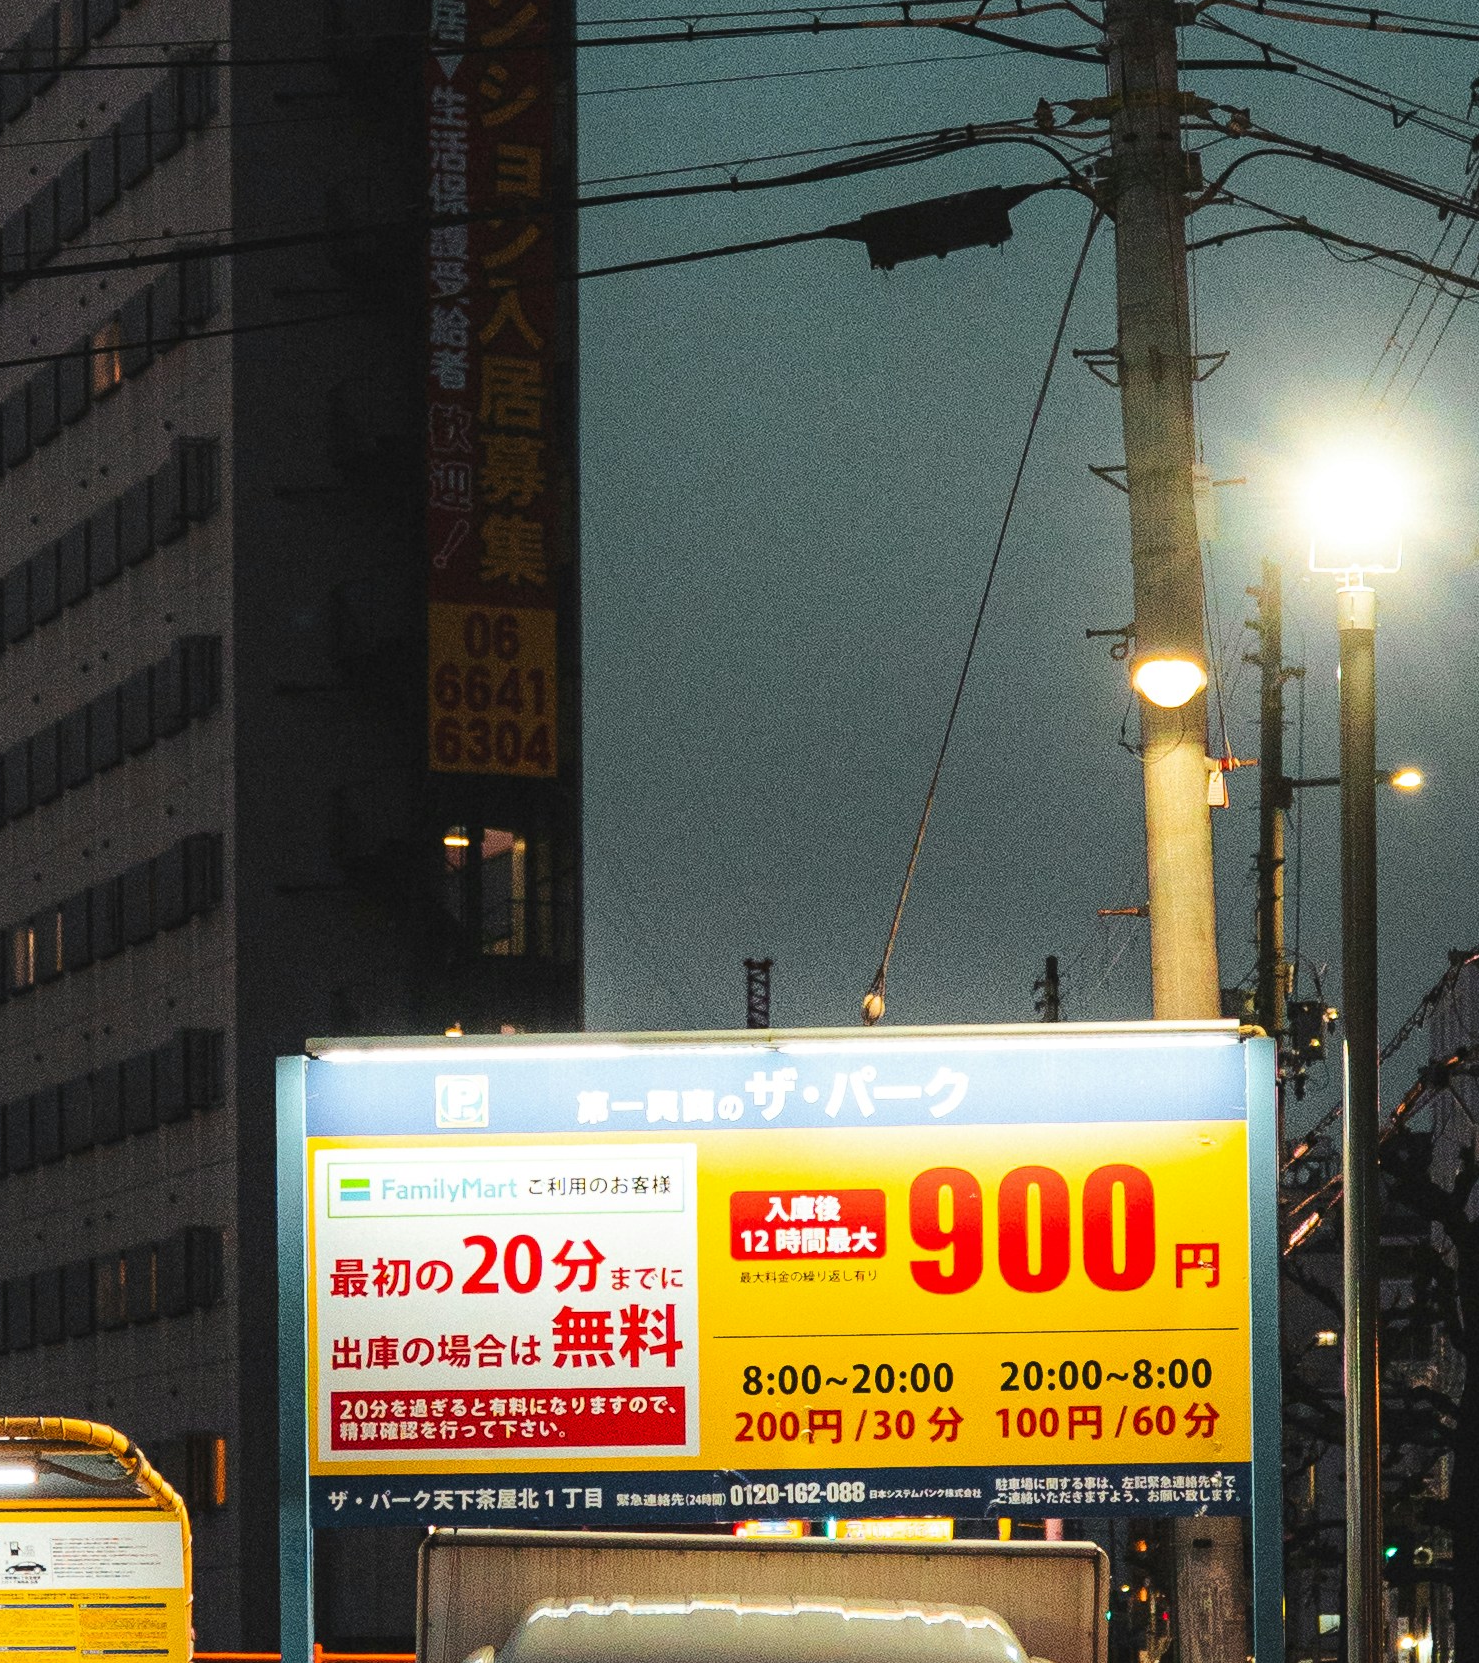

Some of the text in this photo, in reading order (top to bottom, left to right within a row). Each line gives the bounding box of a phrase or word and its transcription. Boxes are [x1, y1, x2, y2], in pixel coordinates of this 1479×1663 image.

[464, 611, 520, 662] 06
[434, 663, 546, 716] 6641
[435, 716, 552, 768] 6304
[381, 1175, 672, 1203] FamilyMart ご利用のお客様
[764, 1195, 841, 1224] 入庫後
[339, 1418, 568, 1442] 精算確認を行って下さい。
[729, 1480, 866, 1507] 0120-162-088
